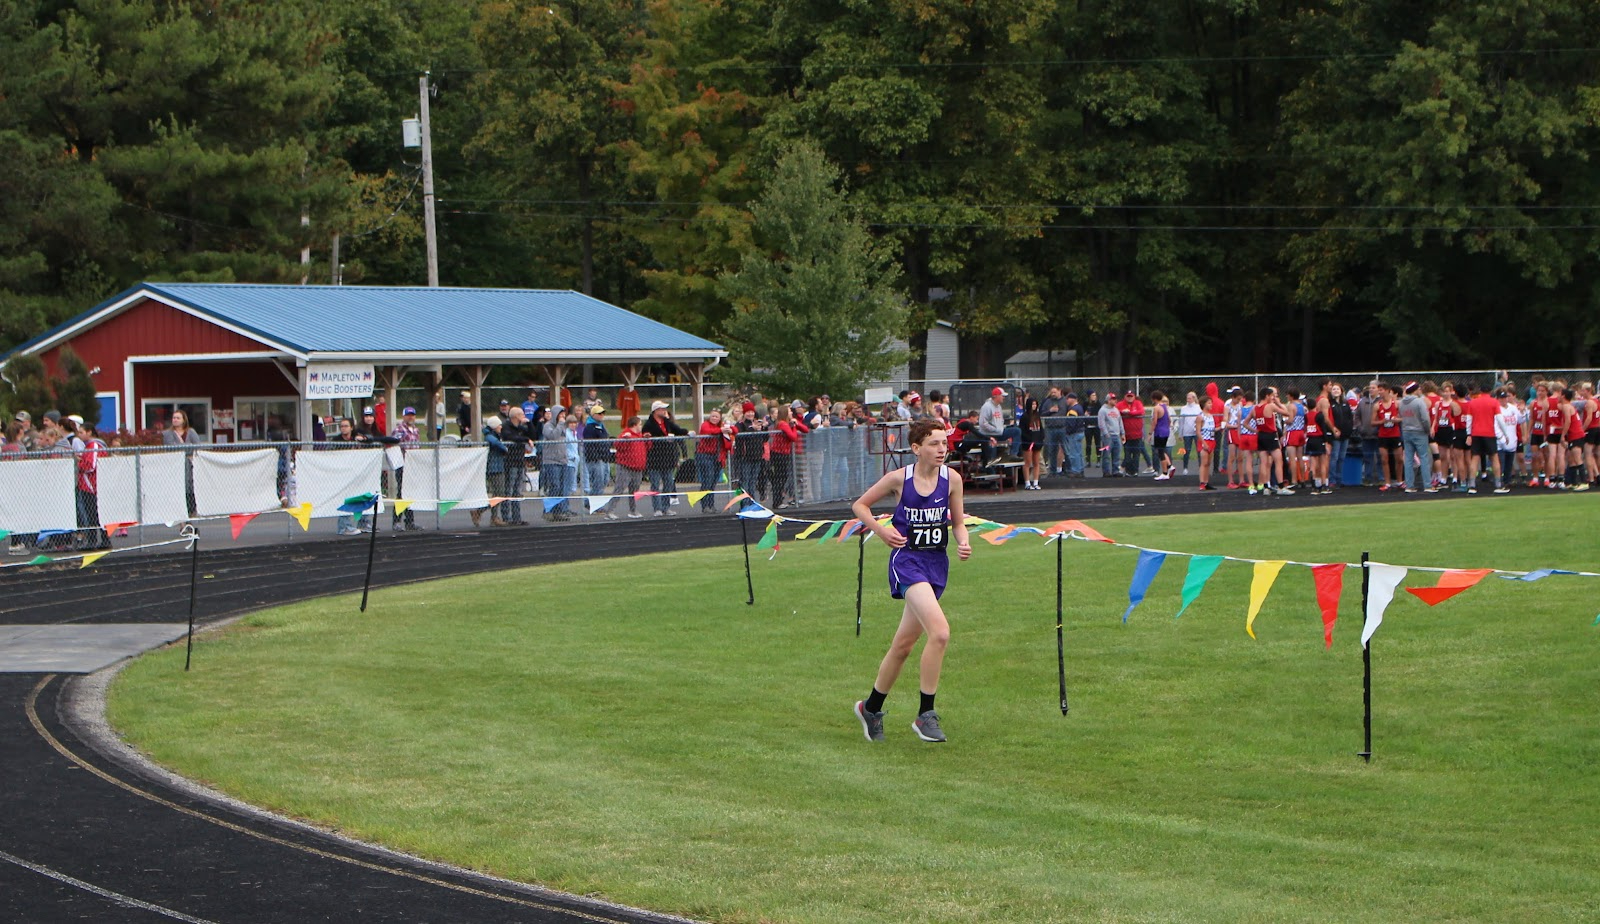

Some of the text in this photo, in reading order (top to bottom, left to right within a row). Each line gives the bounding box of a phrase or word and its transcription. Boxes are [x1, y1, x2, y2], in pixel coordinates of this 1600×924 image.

[321, 372, 361, 382] MAPLETON
[309, 384, 372, 395] MUSIC BOOSTERS
[904, 506, 947, 523] TRIWAY
[913, 528, 943, 545] 719
